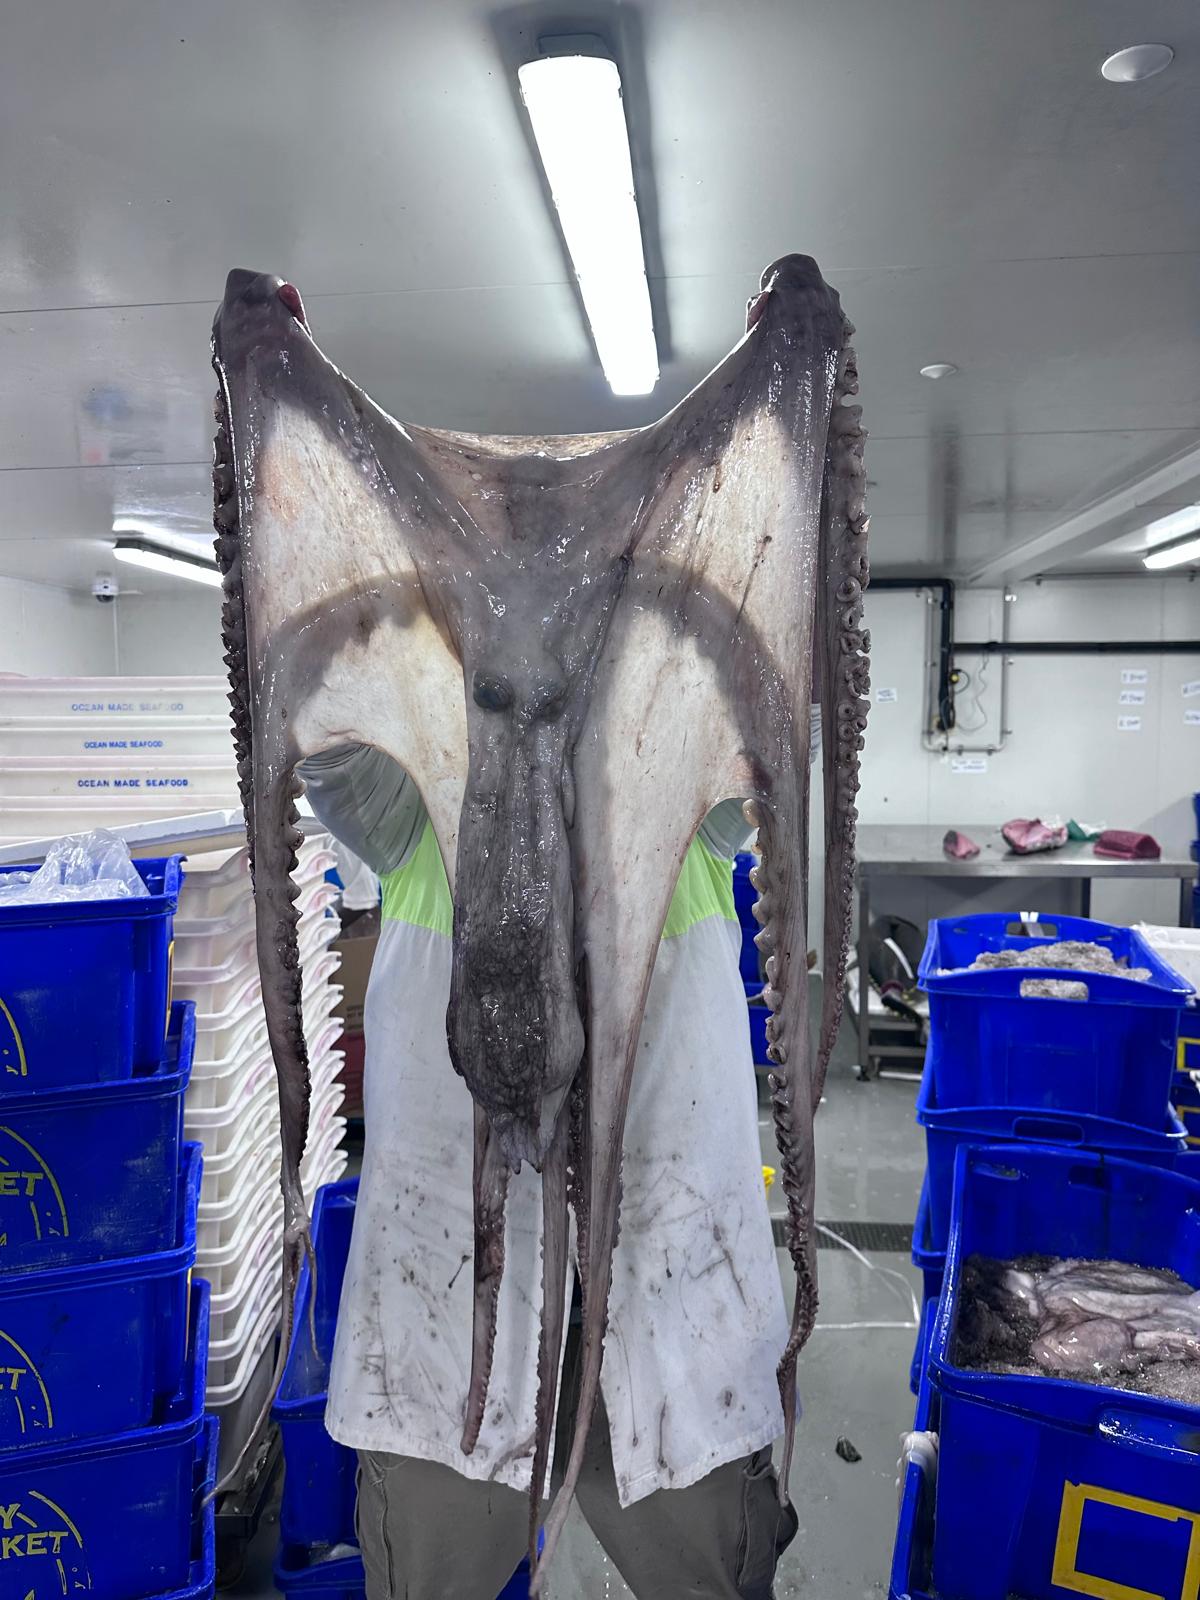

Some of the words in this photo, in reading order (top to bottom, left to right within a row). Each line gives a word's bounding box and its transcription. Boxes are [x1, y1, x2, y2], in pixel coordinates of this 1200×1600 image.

[71, 703, 104, 711] OCEAN
[107, 703, 135, 711] MADE
[130, 740, 163, 748] SEAFOOD
[114, 779, 141, 787] MADE
[146, 779, 189, 787] SEAFOOD
[0, 1531, 70, 1560] KET
